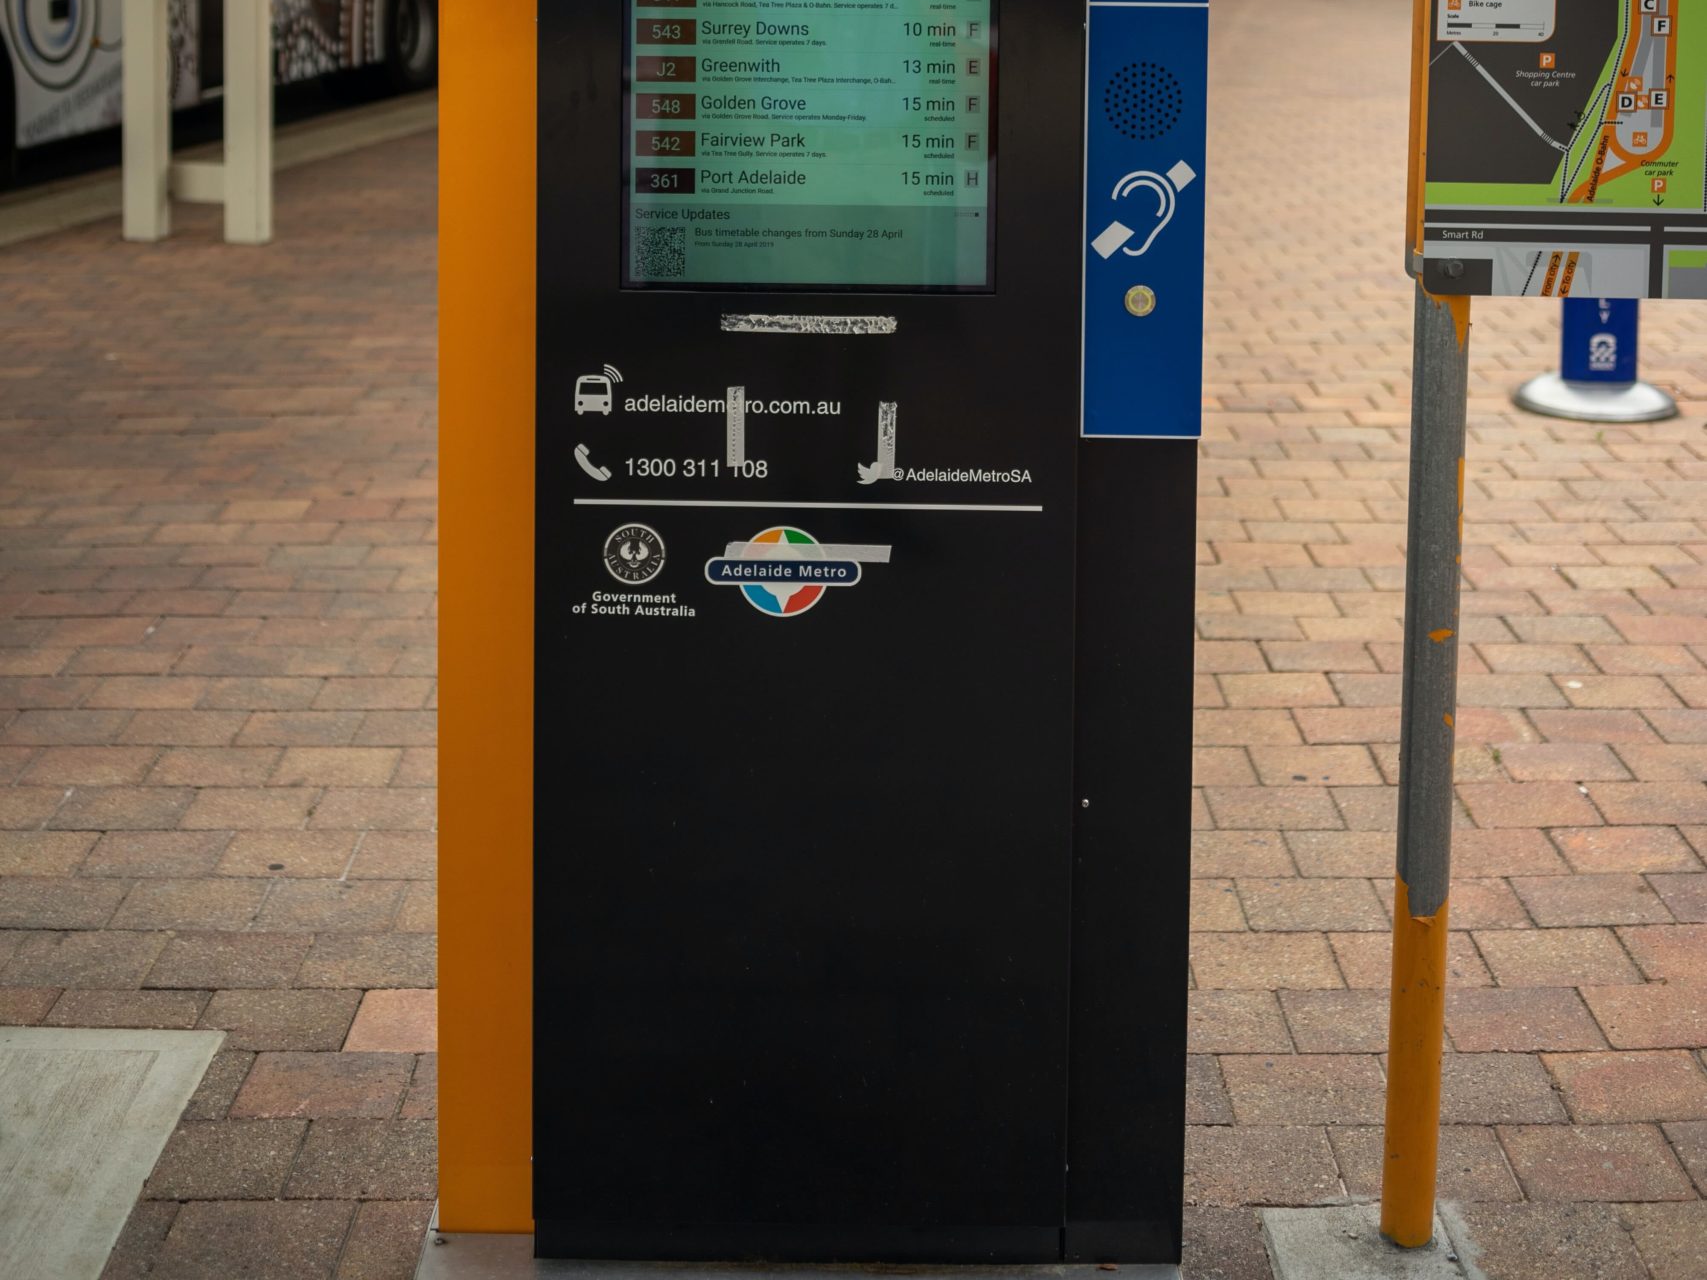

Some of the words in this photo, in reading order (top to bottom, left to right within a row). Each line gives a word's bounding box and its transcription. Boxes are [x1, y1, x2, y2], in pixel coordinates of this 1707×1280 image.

[652, 25, 680, 39] 543
[702, 21, 751, 38] Surrey
[756, 21, 809, 36] Downs
[904, 23, 922, 36] 10
[928, 23, 956, 36] min
[656, 62, 676, 76] J2
[702, 58, 780, 72] Greenwith
[1516, 70, 1550, 79] Shopping
[1531, 78, 1542, 86] car
[1543, 78, 1560, 88] park
[652, 99, 680, 113] 548
[701, 95, 755, 109] Golden
[761, 96, 806, 110] Grove
[651, 137, 680, 151] 542
[701, 133, 765, 147] Fairview
[771, 133, 805, 147] Park
[701, 170, 733, 184] Port
[738, 170, 806, 184] Adelaide
[1657, 169, 1674, 177] park
[651, 174, 677, 188] 361
[636, 208, 678, 219] Service
[682, 209, 730, 222] Updates
[695, 227, 712, 236] Bus
[715, 228, 759, 237] timetable
[762, 228, 802, 239] changes
[805, 228, 827, 238] from
[829, 229, 865, 240] Sunday
[867, 229, 879, 238] 28
[881, 229, 903, 240] April
[1443, 230, 1469, 239] Smart
[1472, 231, 1483, 239] Rd
[625, 395, 841, 416] adelaidemro.com.au
[625, 458, 676, 477] 1300
[683, 459, 718, 477] 311
[732, 460, 768, 478] 108
[892, 469, 1032, 483] @AdelaideMetroSA
[615, 528, 654, 543] SOUTH
[608, 554, 661, 580] AUSTRALIA
[721, 564, 792, 577] Adelaide
[799, 564, 847, 578] Metro
[592, 591, 676, 605] Government
[572, 603, 587, 613] of
[591, 603, 630, 615] South
[635, 605, 695, 616] Australia
